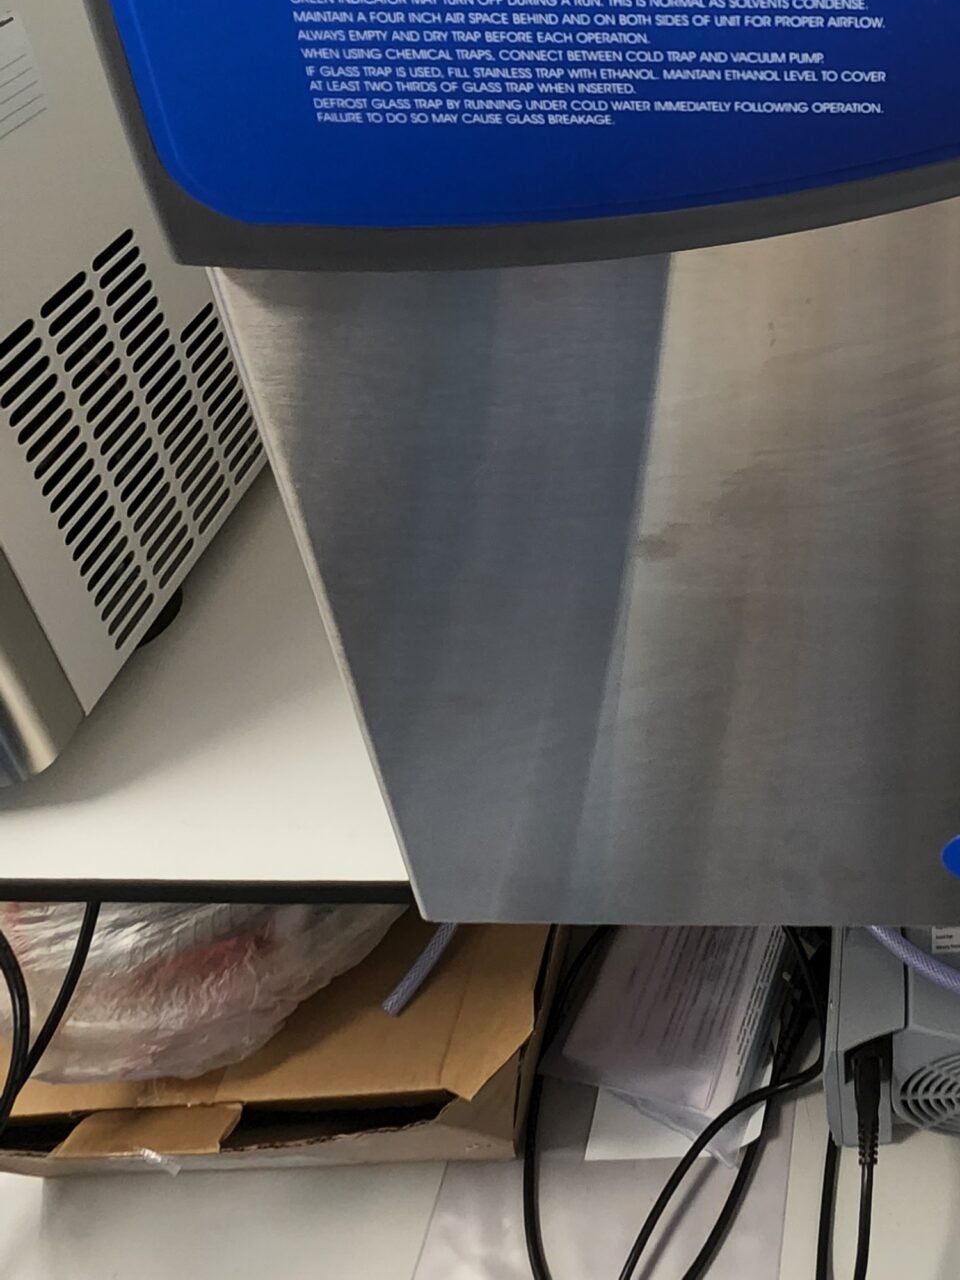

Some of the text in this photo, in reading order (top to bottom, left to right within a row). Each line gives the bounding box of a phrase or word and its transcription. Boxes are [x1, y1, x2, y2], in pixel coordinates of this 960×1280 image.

[292, 11, 355, 22] MAINTAIN
[356, 12, 368, 22] A
[368, 12, 406, 23] FOUR
[407, 12, 442, 23] INCH
[444, 12, 466, 23] AIR
[467, 13, 510, 24] SPACE
[511, 13, 559, 25] BEHIND
[561, 14, 591, 25] AND
[593, 14, 616, 25] ON
[618, 14, 652, 25] BOTH
[654, 15, 690, 26] SIDES
[691, 15, 711, 26] OF
[713, 15, 742, 27] UNIT
[744, 16, 772, 27] FOR
[774, 16, 825, 27] PROPER
[297, 30, 346, 41] ALWAYS
[347, 30, 388, 41] EMPTY
[391, 31, 421, 41] AND
[422, 31, 449, 41] DRY
[450, 31, 482, 42] TRAP
[484, 31, 534, 42] BEFORE
[536, 32, 574, 43] EACH
[300, 48, 341, 59] WHEN
[341, 48, 383, 59] USING
[384, 49, 454, 60] CHEMICAL
[498, 50, 564, 61] CONNECT
[566, 50, 623, 61] BETWEEN
[625, 51, 665, 62] COLD
[666, 51, 697, 62] TRAP
[699, 52, 729, 63] AND
[729, 52, 787, 63] VACUUM
[305, 66, 316, 76] IF
[319, 66, 361, 77] GLASS
[362, 67, 393, 76] TRAP
[395, 67, 407, 77] IS
[447, 67, 471, 78] FILL
[472, 67, 533, 78] STAINLESS
[534, 68, 565, 78] TRAP
[566, 68, 598, 78] WITH
[662, 69, 722, 80] MAINTAIN
[724, 70, 781, 81] ETHANOL
[783, 70, 819, 81] LEVEL
[820, 71, 839, 81] TO
[840, 71, 887, 82] COVER
[309, 81, 323, 90] AT
[325, 81, 361, 91] LEAST
[362, 81, 394, 92] TWO
[394, 81, 438, 92] THIRDS
[439, 82, 459, 92] OF
[461, 82, 503, 92] GLASS
[504, 82, 535, 92] TRAP
[536, 83, 576, 93] WHEN
[312, 98, 368, 109] DEFROST
[370, 99, 412, 109] GLASS
[413, 99, 444, 109] TRAP
[445, 99, 461, 109] BY
[463, 99, 523, 110] RUNNING
[524, 100, 568, 110] UNDER
[570, 100, 609, 111] COLD
[609, 101, 651, 111] WATER
[653, 101, 732, 112] IMMEDIATELY
[733, 102, 810, 113] FOLLOWING
[316, 112, 364, 123] FAILURE
[365, 113, 384, 123] TO
[385, 113, 408, 123] DO
[409, 113, 430, 123] SO
[431, 114, 459, 123] MAY
[461, 113, 503, 124] CAUSE
[505, 114, 546, 124] GLASS
